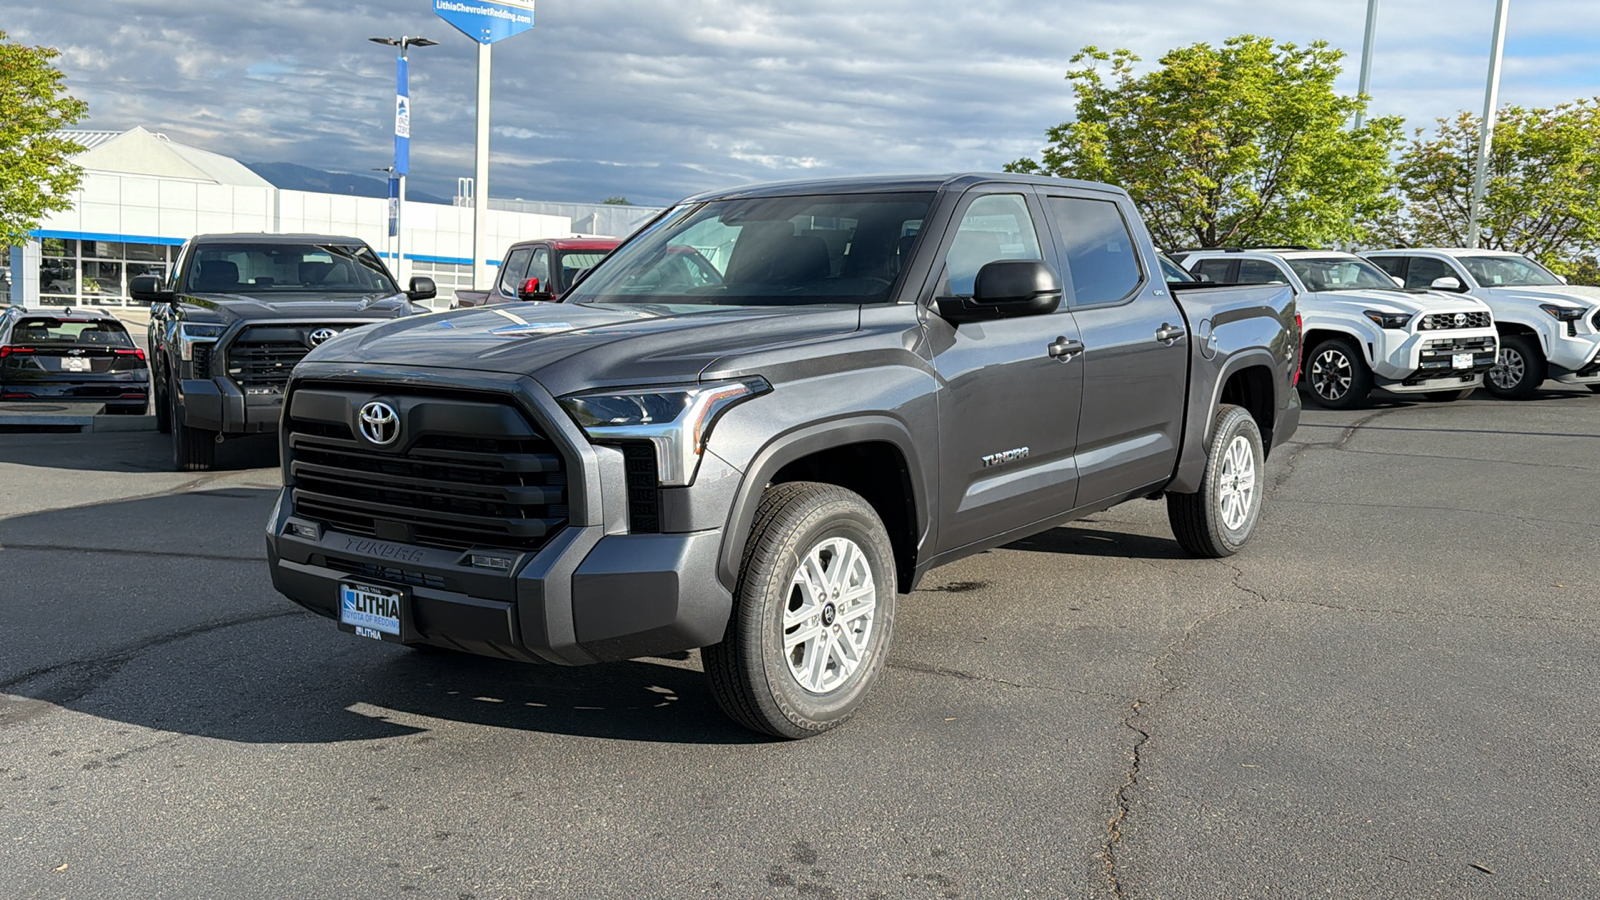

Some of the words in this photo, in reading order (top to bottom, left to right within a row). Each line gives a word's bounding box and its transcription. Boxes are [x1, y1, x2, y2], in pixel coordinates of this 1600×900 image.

[436, 1, 531, 23] LithiaChevroletRedding.com
[981, 446, 1029, 467] TUNDRA
[346, 538, 424, 563] TUNDRA
[355, 592, 400, 620] LITHIA
[343, 609, 365, 621] TOYOTA
[364, 613, 373, 622] OF
[374, 616, 399, 629] REDDING
[361, 627, 382, 641] LITHIA
